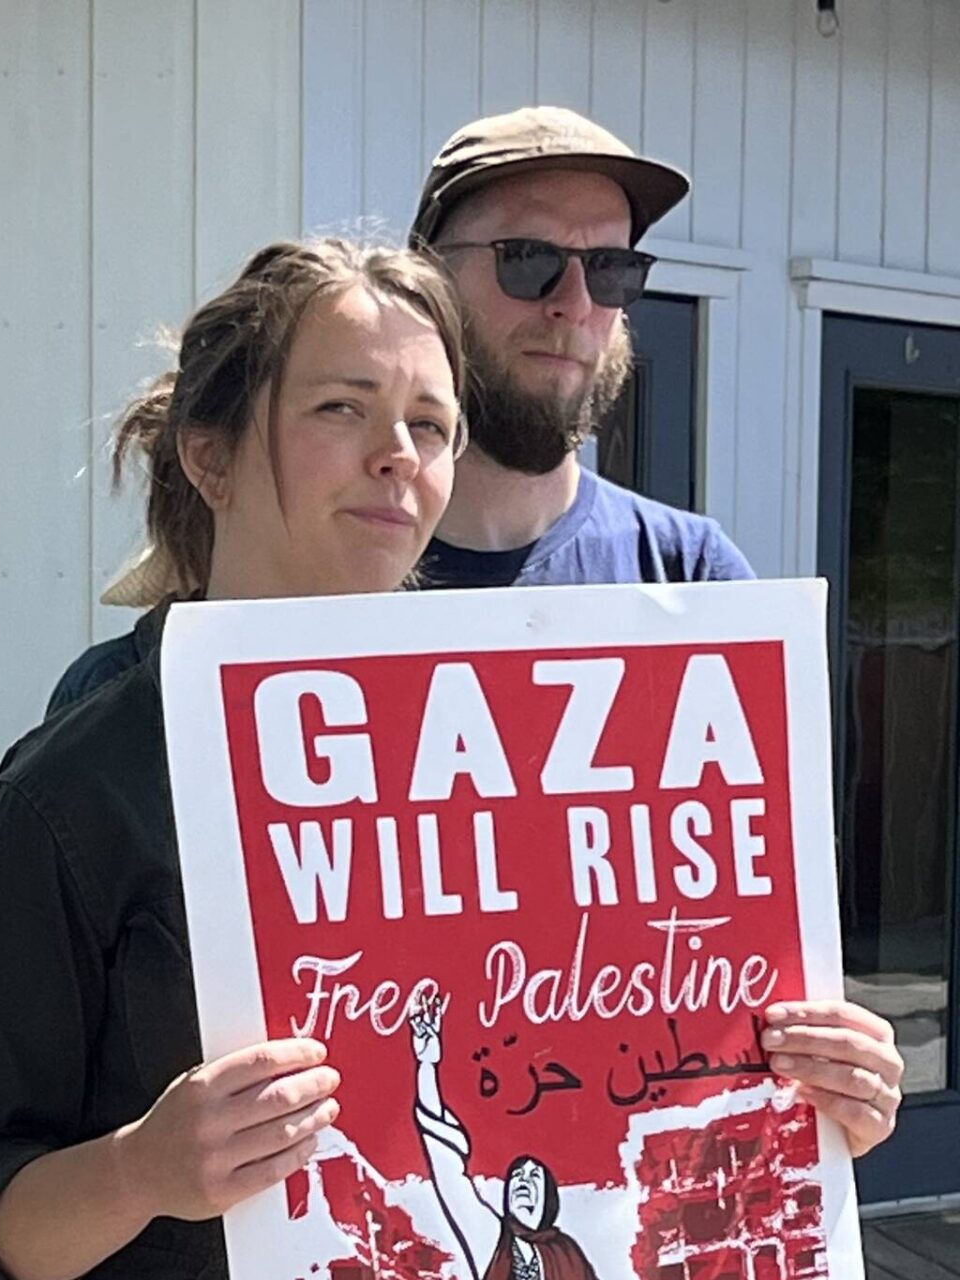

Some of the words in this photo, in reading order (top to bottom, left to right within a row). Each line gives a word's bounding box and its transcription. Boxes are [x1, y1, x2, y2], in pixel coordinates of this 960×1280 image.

[253, 653, 765, 807] GAZA
[267, 809, 519, 924] WILL
[566, 797, 773, 907] RISE
[290, 950, 451, 1041] Free
[478, 907, 779, 1028] Palestine
[606, 1012, 772, 1107] لسطين
